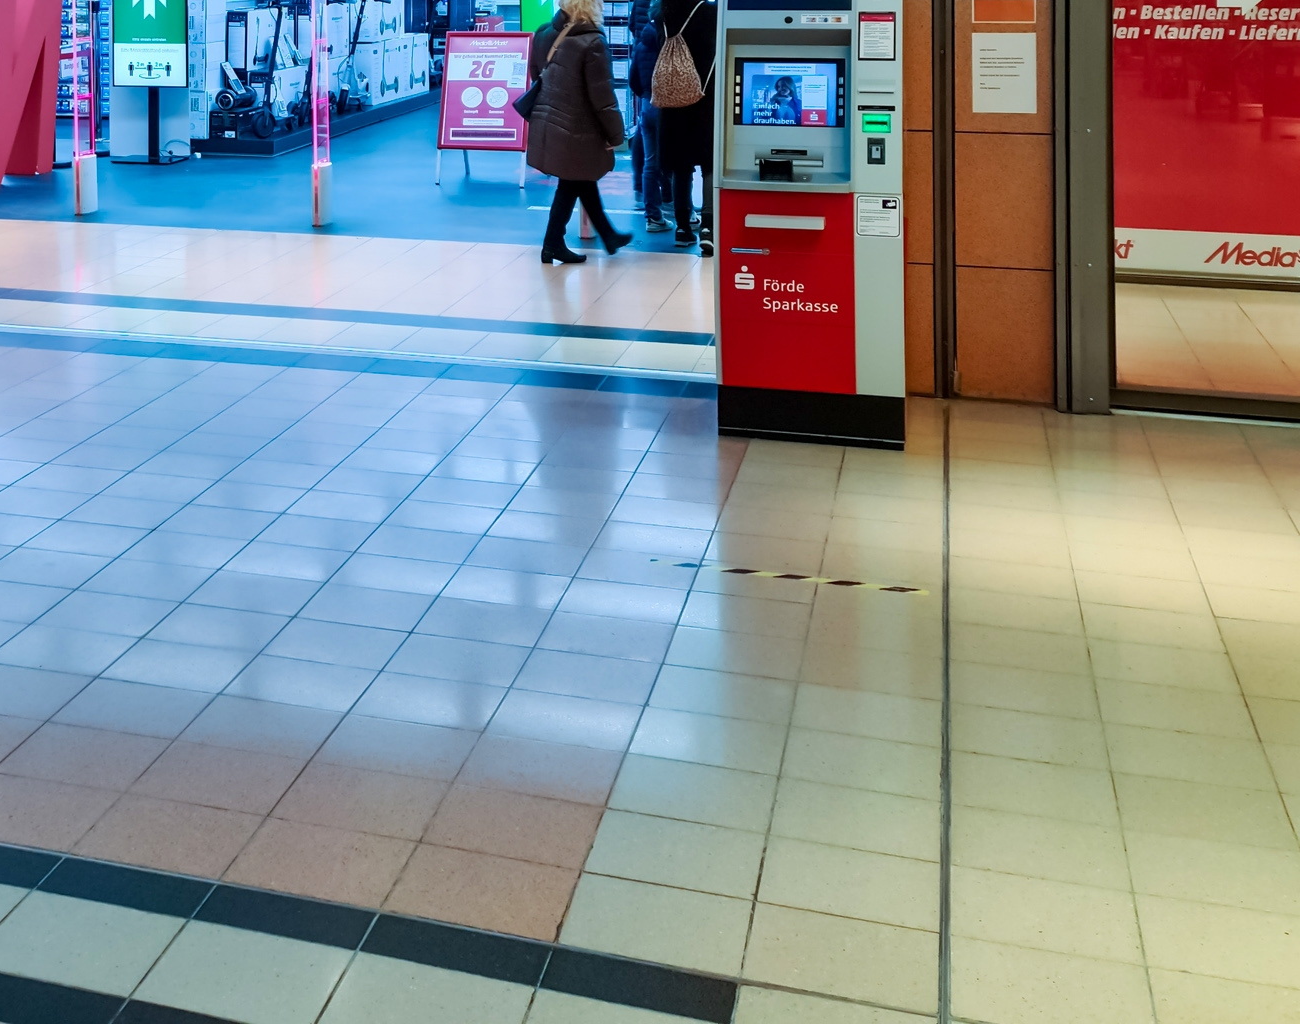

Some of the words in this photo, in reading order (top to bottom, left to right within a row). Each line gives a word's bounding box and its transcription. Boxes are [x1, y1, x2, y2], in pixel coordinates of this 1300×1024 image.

[1140, 4, 1230, 21] Bestellen
[1154, 24, 1225, 40] Kaufen
[469, 60, 496, 79] 2G
[752, 102, 780, 110] Einfach
[753, 117, 797, 125] draufhaben.
[1204, 241, 1298, 268] Media
[763, 278, 805, 293] Förde
[762, 297, 839, 313] Sparkasse
